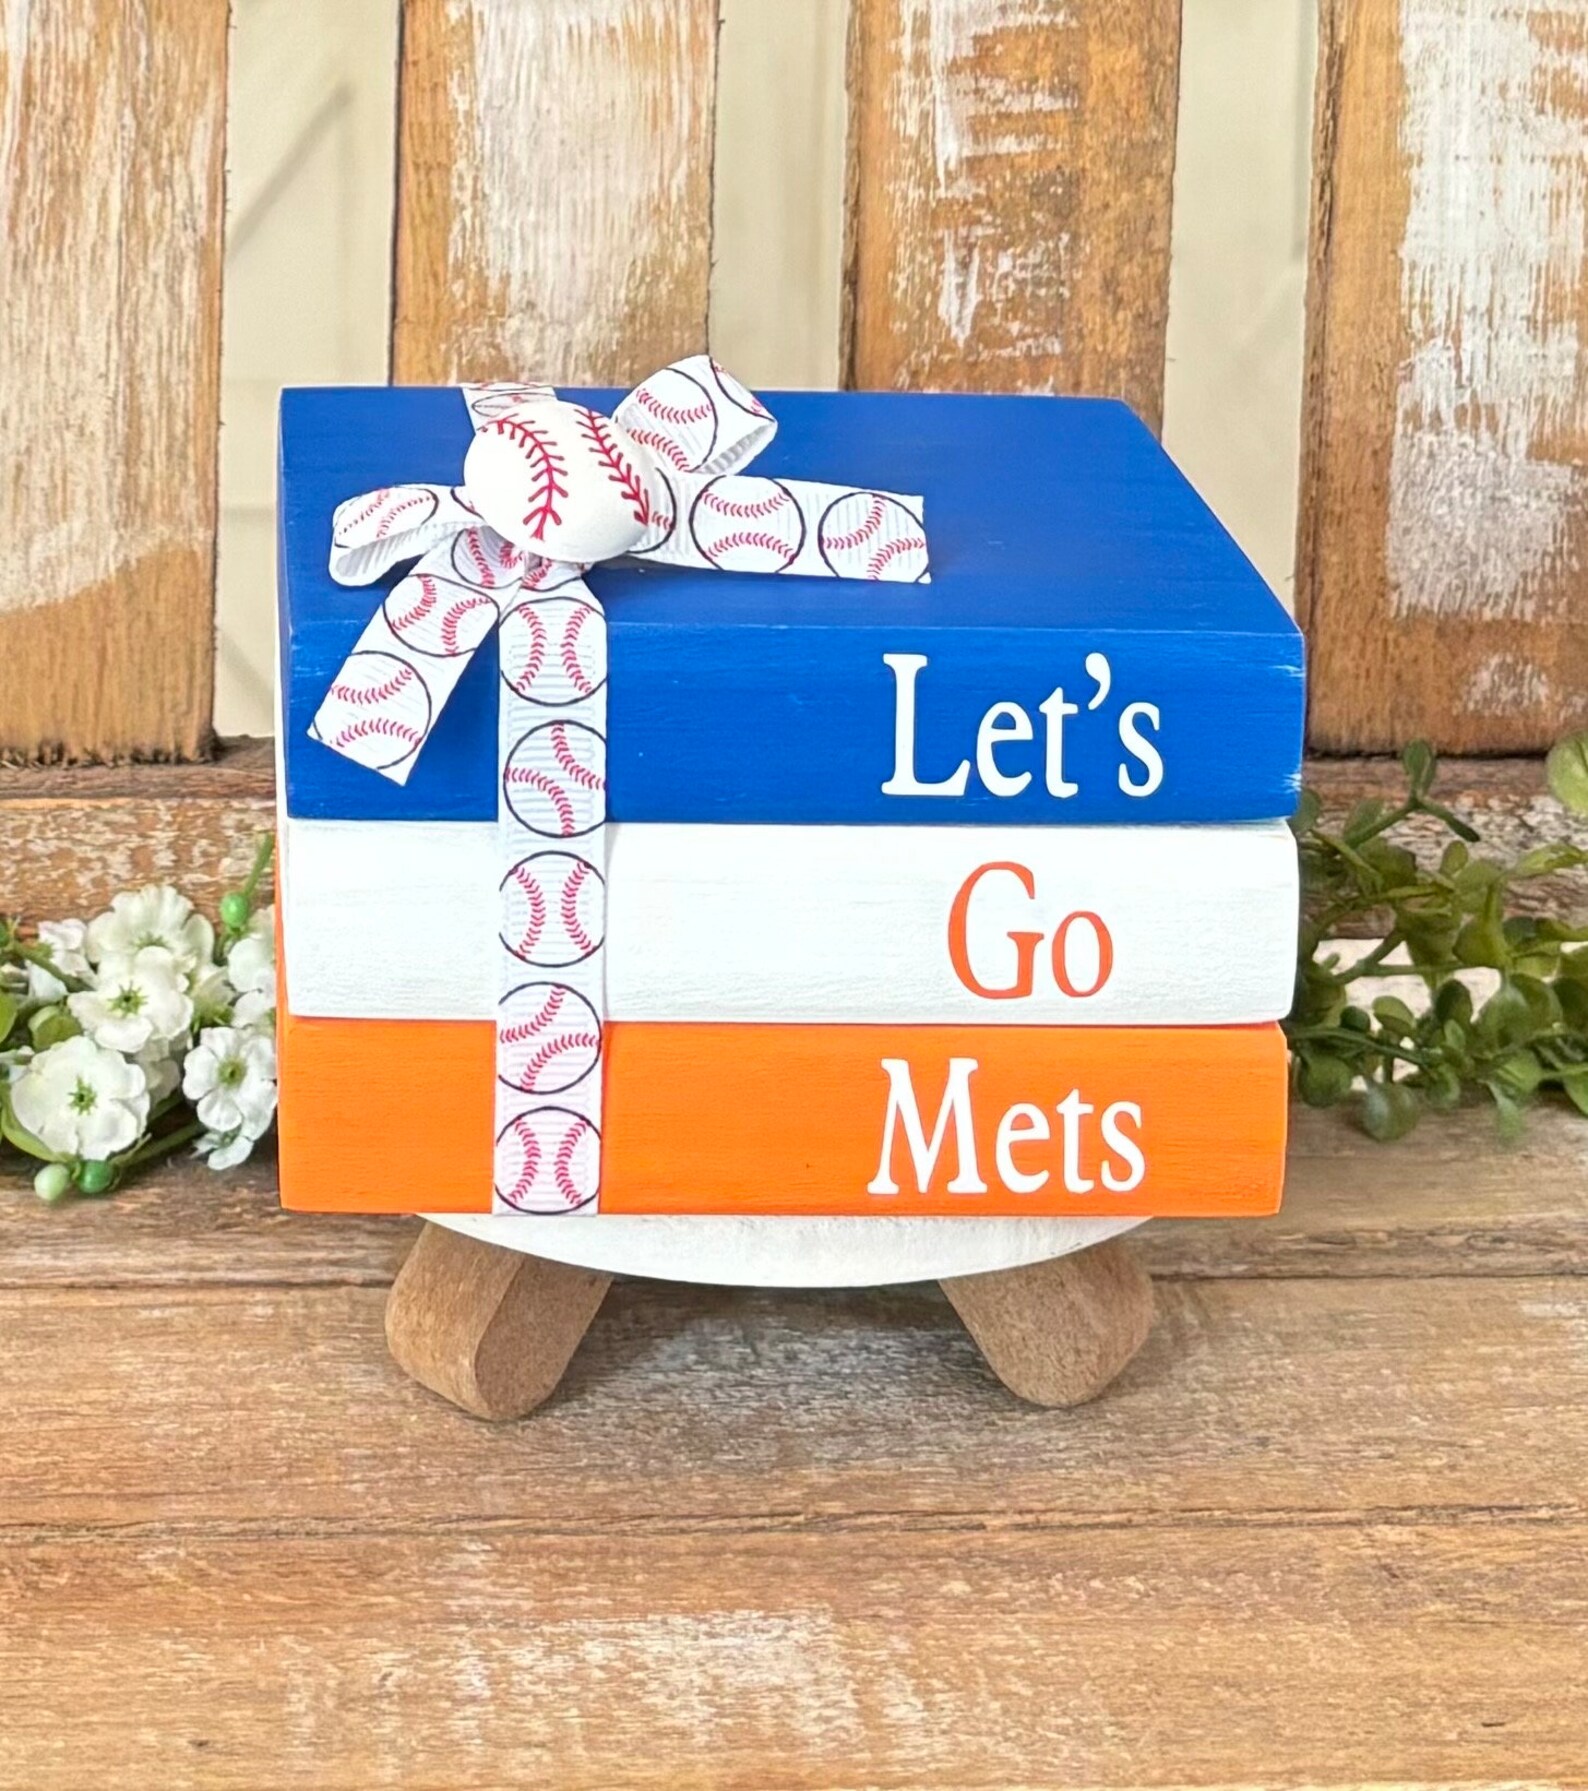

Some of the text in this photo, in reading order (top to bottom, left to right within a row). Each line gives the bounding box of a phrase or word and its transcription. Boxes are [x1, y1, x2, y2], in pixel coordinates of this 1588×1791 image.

[881, 653, 1164, 799] Let's
[947, 860, 1114, 1000] Go
[867, 1057, 1146, 1195] Mets
